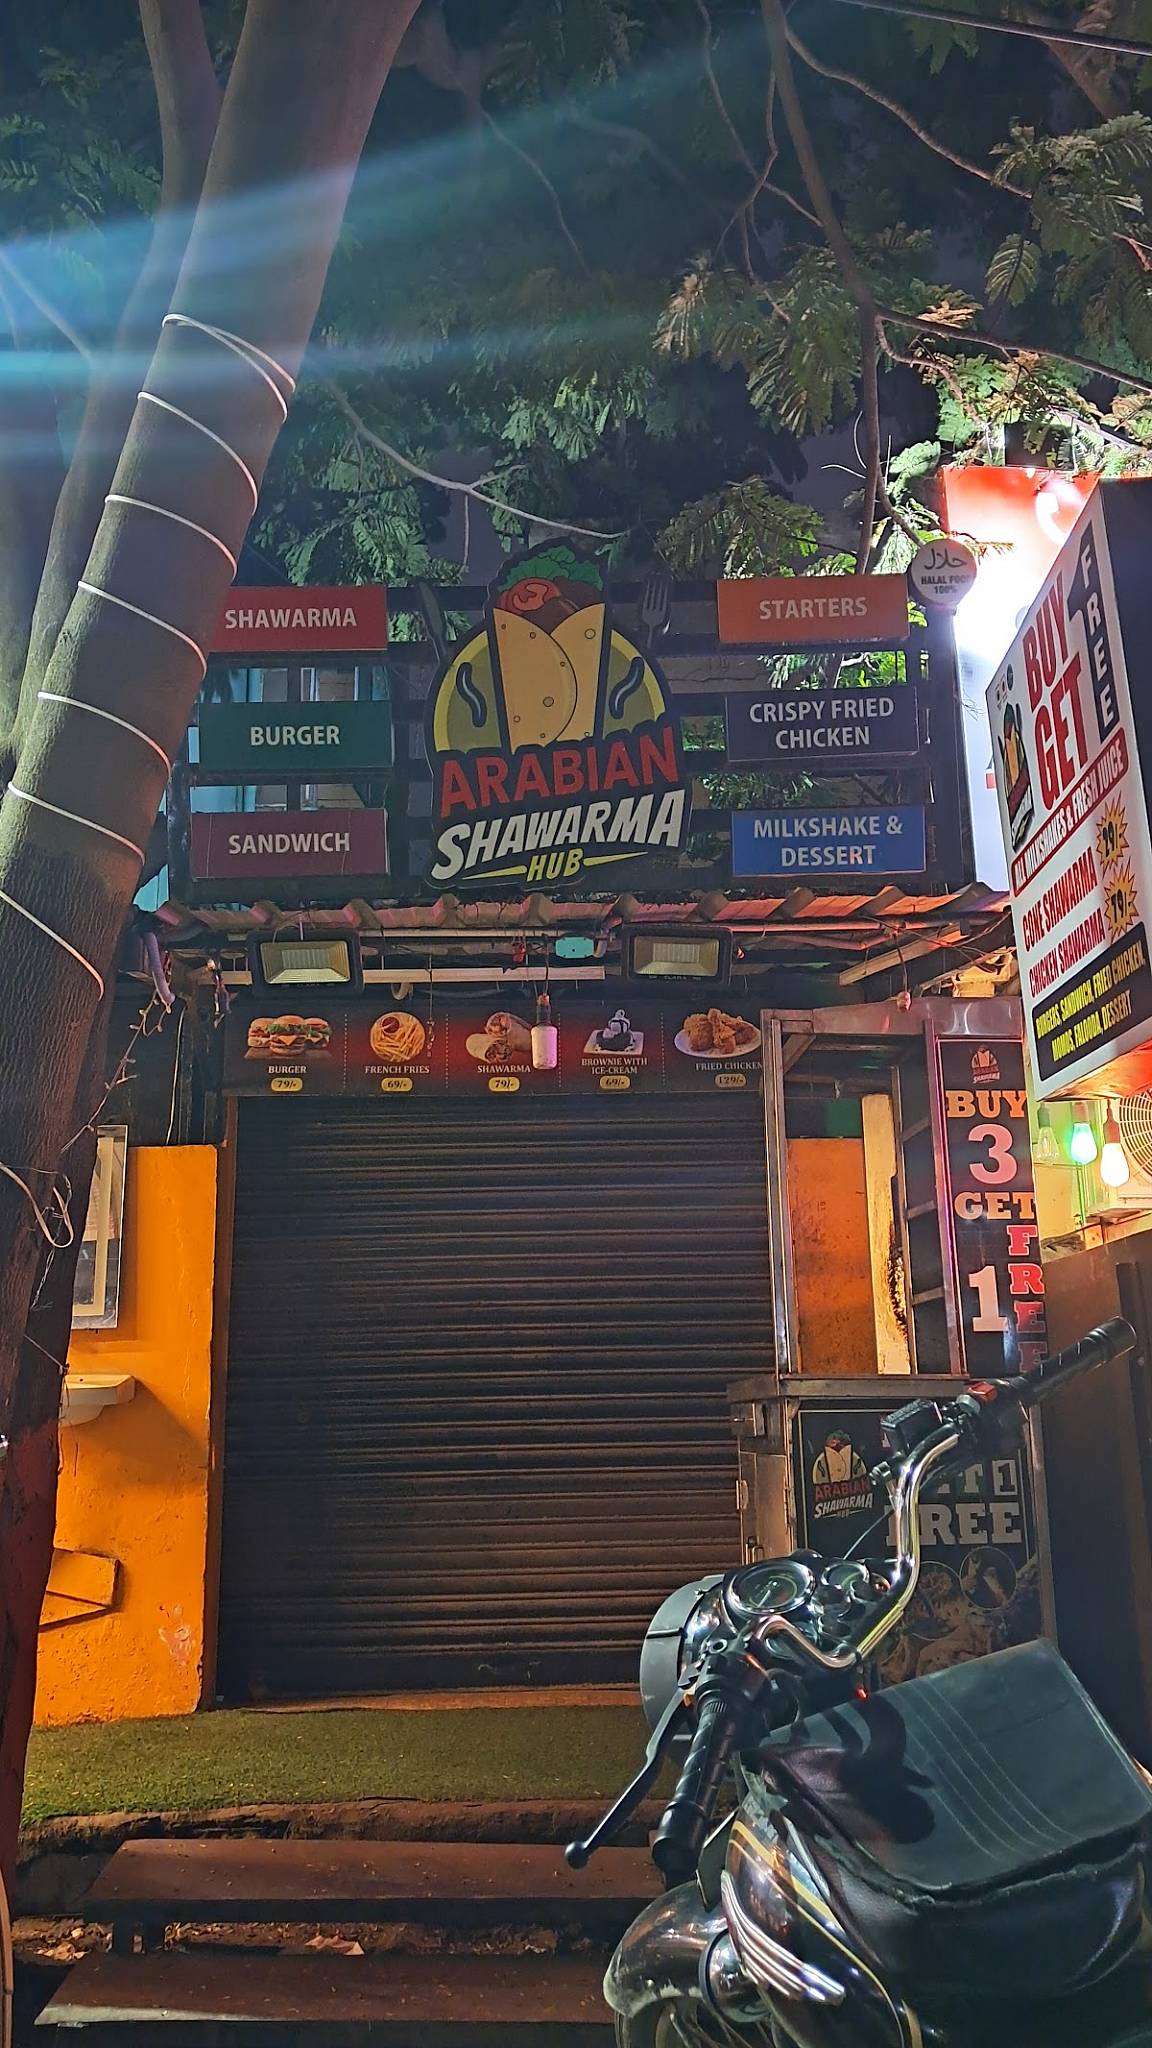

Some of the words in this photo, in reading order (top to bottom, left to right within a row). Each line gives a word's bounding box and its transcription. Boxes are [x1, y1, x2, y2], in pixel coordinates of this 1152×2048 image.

[924, 548, 967, 570] حلال
[921, 576, 948, 585] HALAL
[225, 607, 357, 629] SHAWARMA
[759, 597, 867, 620] STARTERS
[1022, 571, 1069, 713] BUY
[1081, 544, 1114, 729] FREE
[749, 700, 825, 723] CRISPY
[831, 697, 894, 719] FRIED
[250, 725, 340, 746] BURGER
[775, 726, 870, 749] CHICKEN
[1034, 652, 1088, 811] GET
[440, 726, 680, 819] ARABIAN
[1024, 808, 1067, 876] MILKSHAKES
[1066, 806, 1074, 831] &
[1072, 770, 1099, 823] FRESH
[1097, 743, 1124, 793] JUICE
[430, 789, 686, 881] SHAWARMA
[754, 816, 880, 839] MILKSHAKE
[886, 815, 903, 834] &
[228, 832, 351, 855] SANDWICH
[781, 845, 876, 867] DESSERT
[526, 847, 584, 883] HUB
[1023, 900, 1045, 952] CONE
[1043, 846, 1098, 932] SHAWARMA
[1029, 949, 1059, 998] CHICKEN
[1058, 907, 1106, 975] SHAWARMA
[1092, 965, 1113, 998] FRIED
[1101, 988, 1132, 1031] DESSERT
[268, 1065, 308, 1074] BURGER
[365, 1065, 402, 1074] FRENCH
[403, 1065, 430, 1074] FRIES
[477, 1064, 531, 1074] SHAWARMA
[581, 1058, 622, 1067] BROWNIE
[623, 1057, 648, 1066] WITH
[591, 1066, 638, 1075] ICE-CREAM
[696, 1062, 723, 1071] FRIED
[724, 1061, 763, 1071] CHICKEN
[276, 1080, 298, 1089] 79/-
[387, 1080, 408, 1088] 69/-
[494, 1079, 515, 1088] 79/-
[946, 1089, 1028, 1118] BUY
[967, 1123, 1018, 1185] 3
[954, 1191, 1037, 1220] GET
[968, 1265, 1008, 1333] 1
[1006, 1225, 1048, 1372] FREE
[815, 1477, 872, 1502] ARABIAN
[814, 1493, 873, 1519] SHAWARMA
